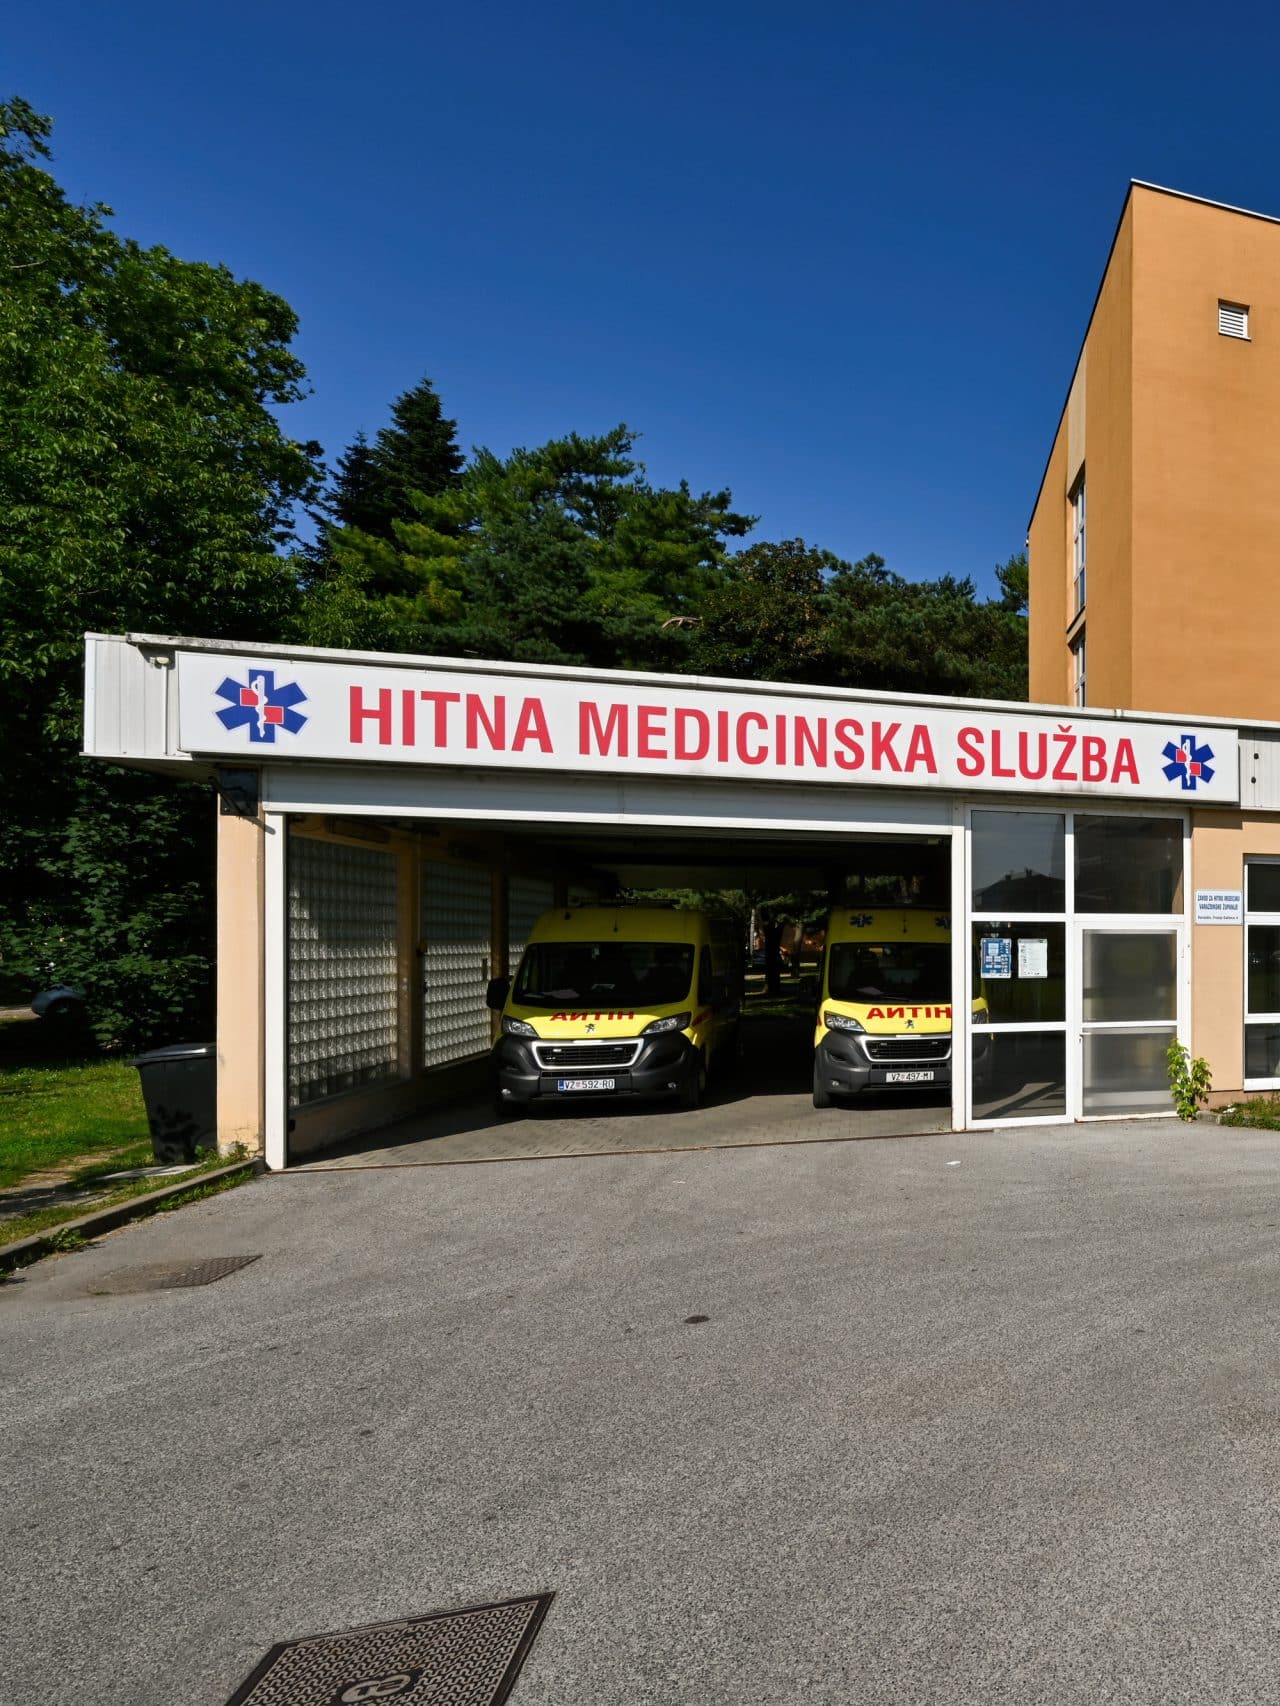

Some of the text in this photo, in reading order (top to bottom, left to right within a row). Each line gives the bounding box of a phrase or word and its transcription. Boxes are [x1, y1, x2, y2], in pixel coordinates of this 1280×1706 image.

[350, 686, 1140, 785] HITNA MEDICINSKA SLUŽBA
[565, 1080, 575, 1089] VZ
